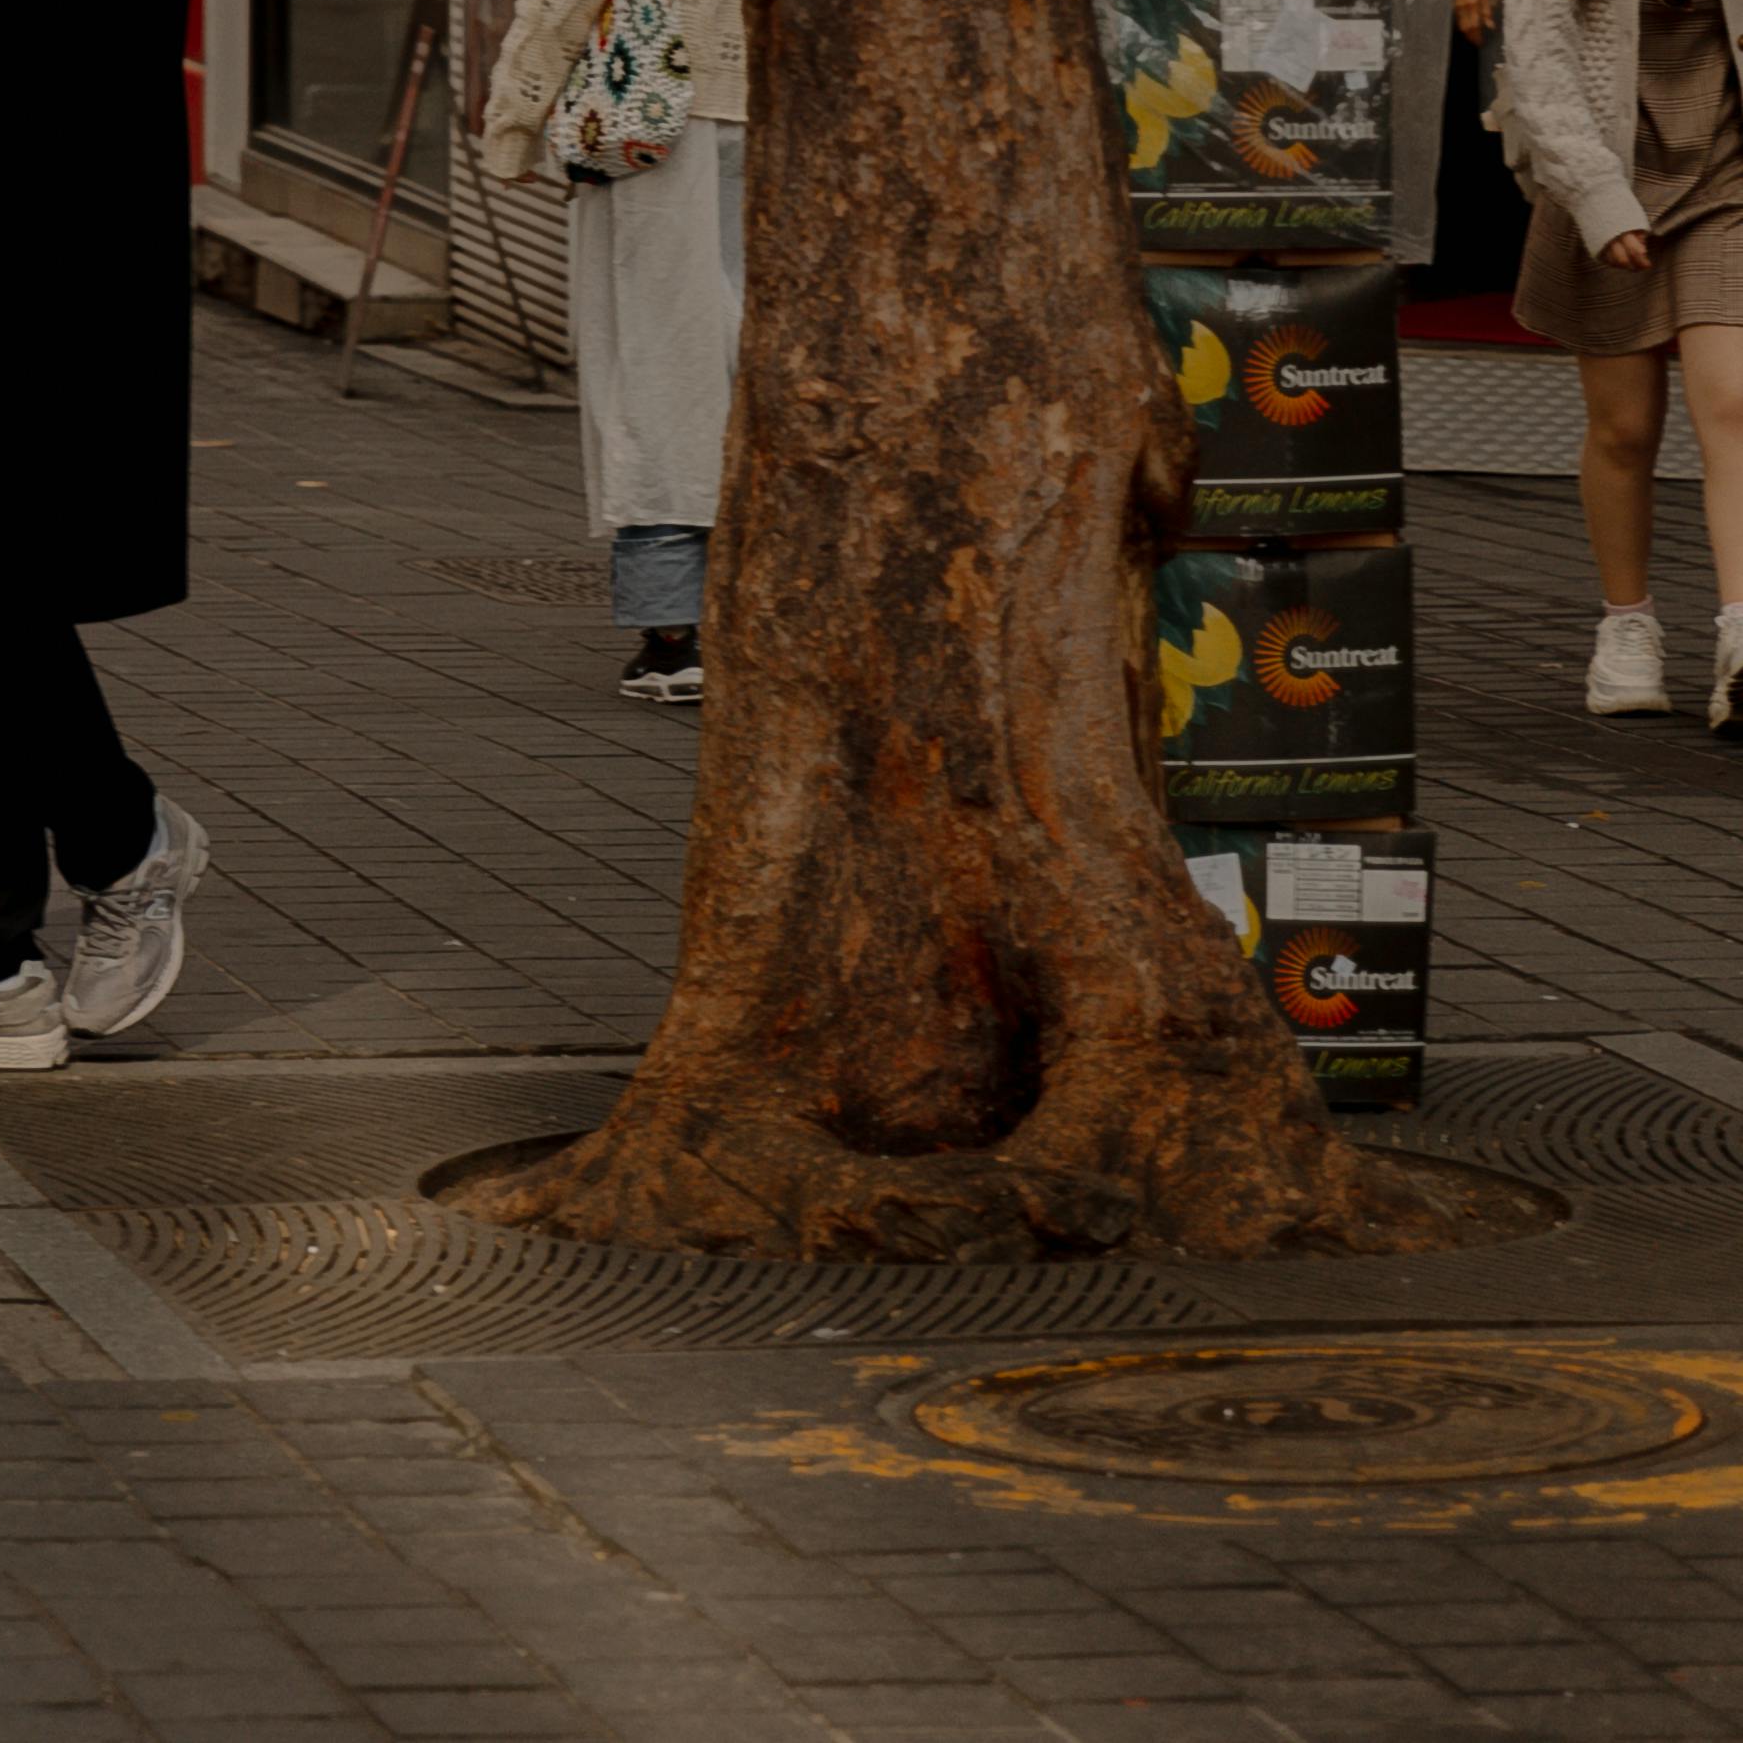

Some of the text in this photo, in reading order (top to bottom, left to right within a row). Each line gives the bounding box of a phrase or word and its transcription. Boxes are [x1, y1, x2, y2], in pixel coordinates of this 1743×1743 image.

[1268, 116, 1380, 141] Suntreat
[1143, 199, 1268, 234] California
[1279, 363, 1388, 389] Suntreat
[1290, 485, 1389, 514] Lemons
[1289, 644, 1401, 671] Suntreat
[1167, 765, 1400, 801] California Lemons
[1308, 964, 1418, 992] Suntreat
[1312, 1049, 1412, 1079] Lemons
